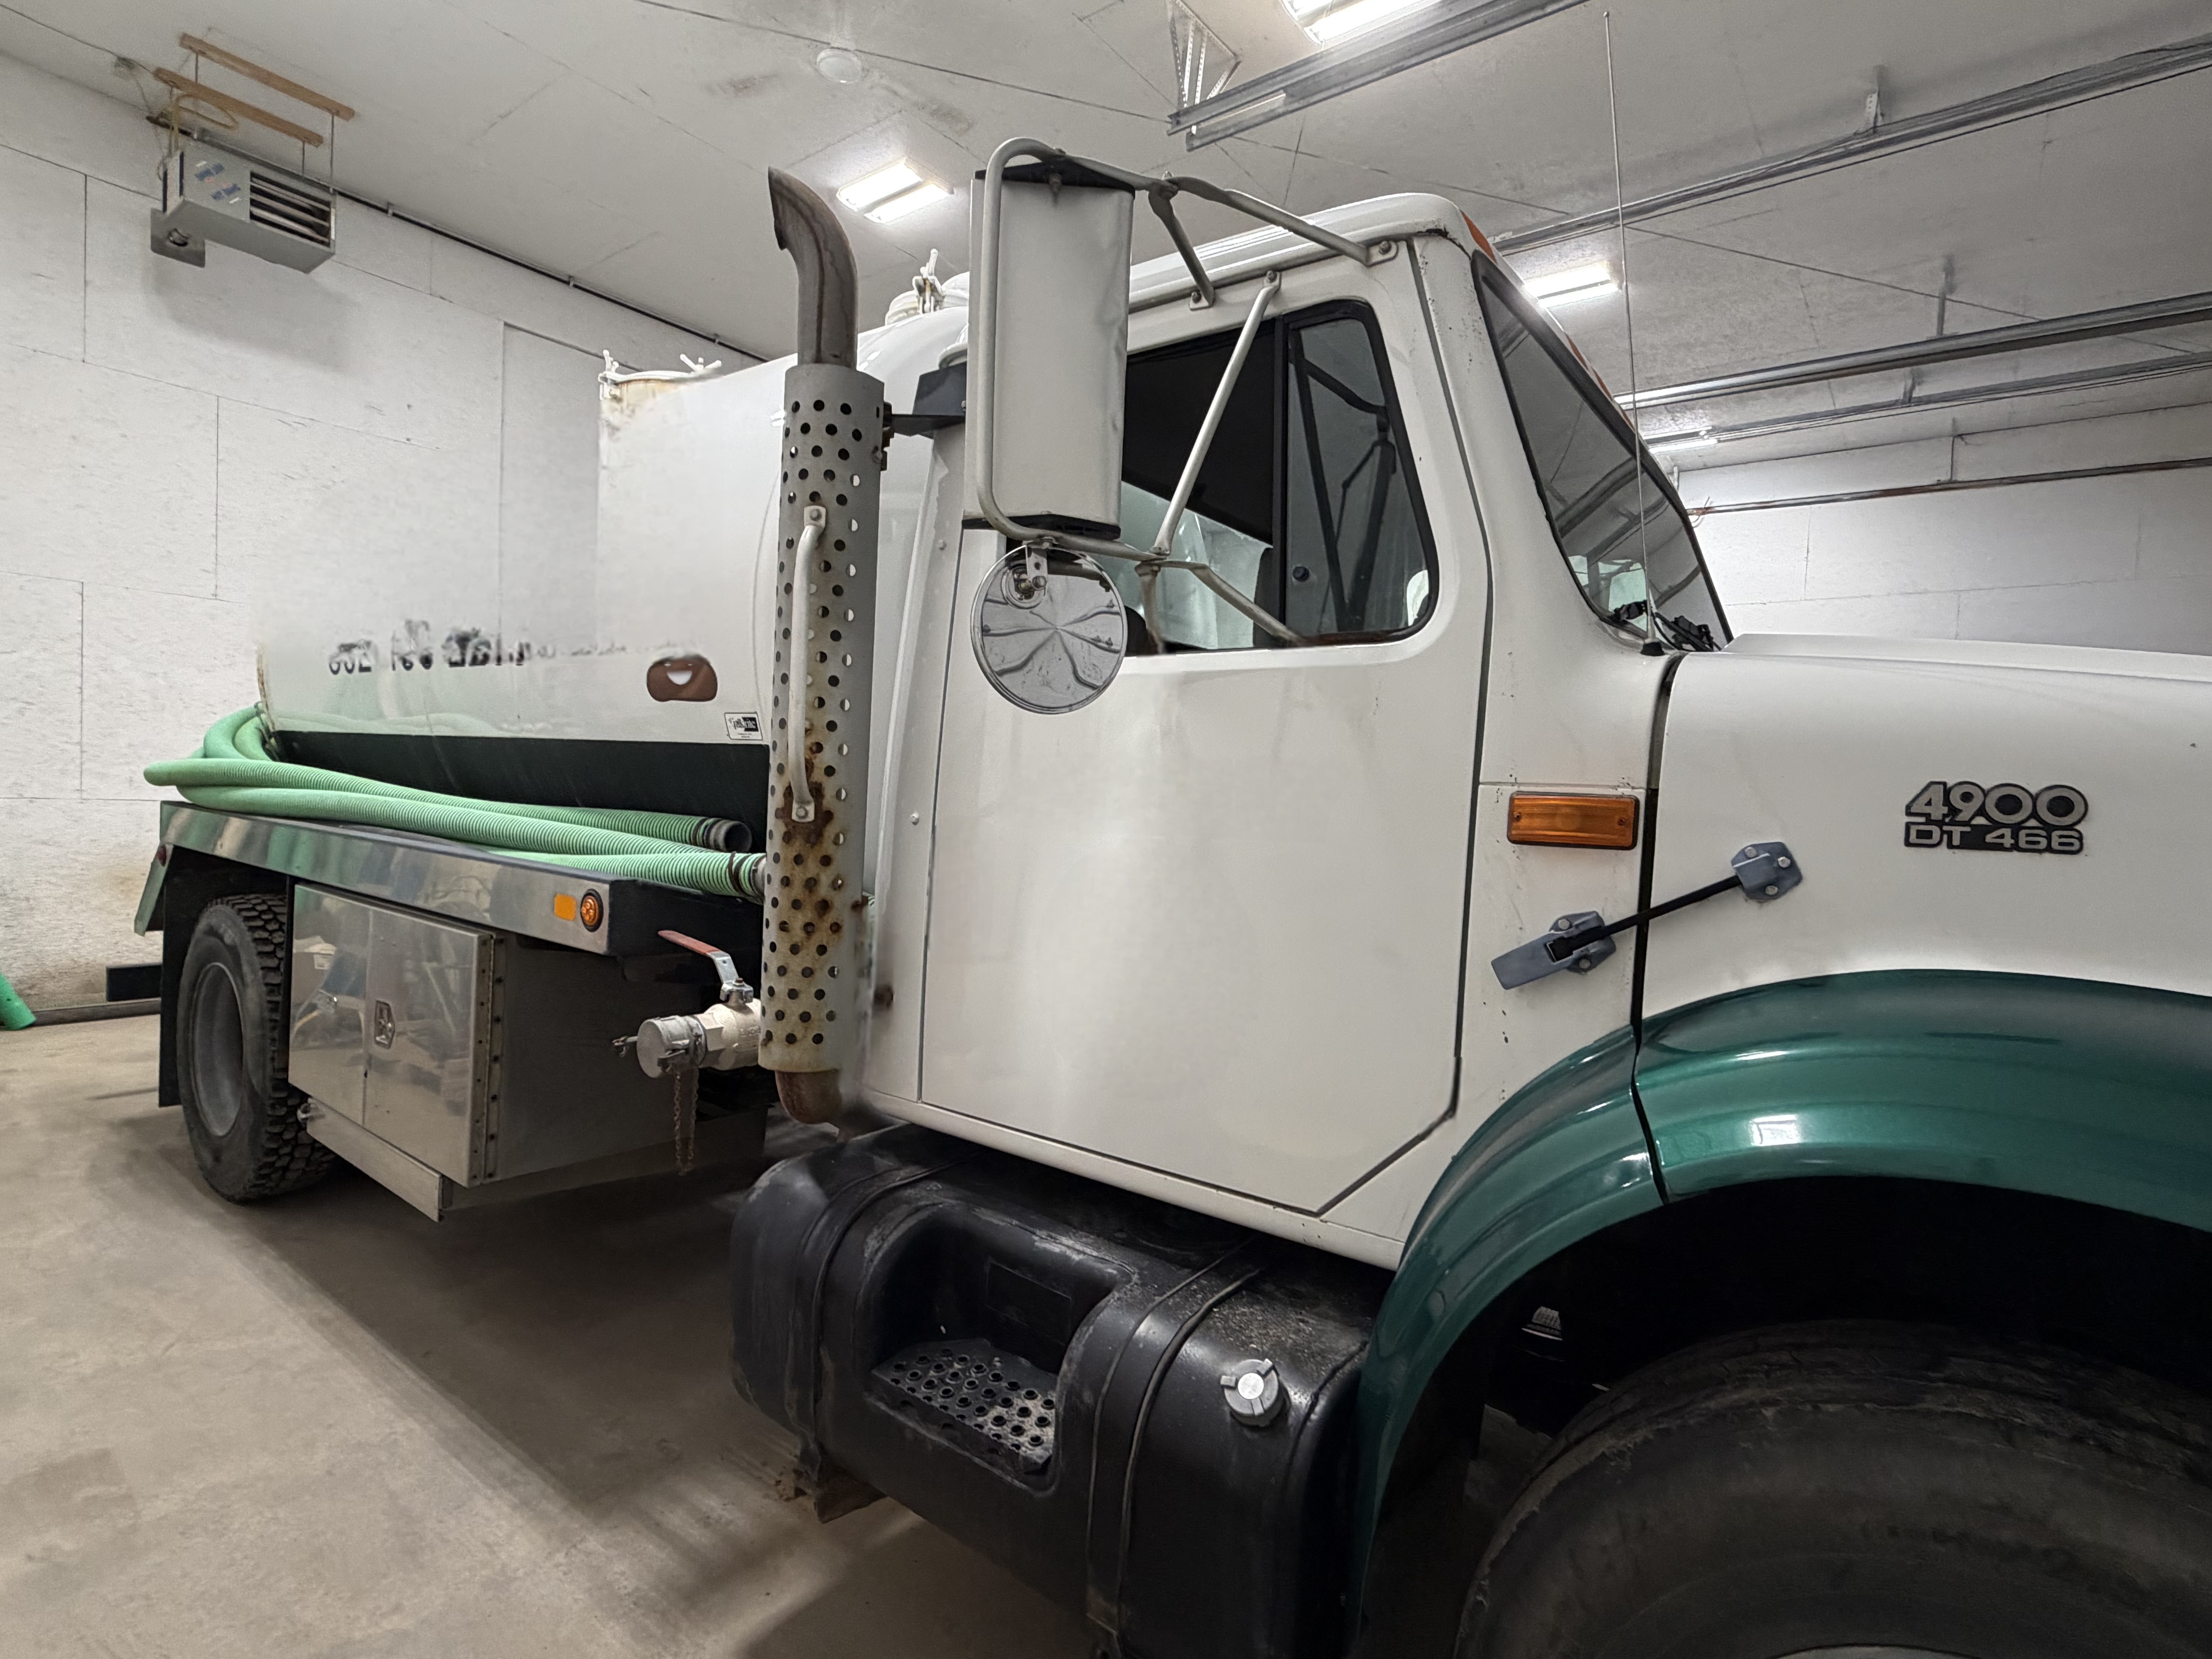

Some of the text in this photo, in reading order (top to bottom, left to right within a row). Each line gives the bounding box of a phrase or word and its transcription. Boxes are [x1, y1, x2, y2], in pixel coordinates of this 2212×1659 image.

[1906, 781, 2088, 827] 4900
[1905, 823, 2082, 853] DT 466
